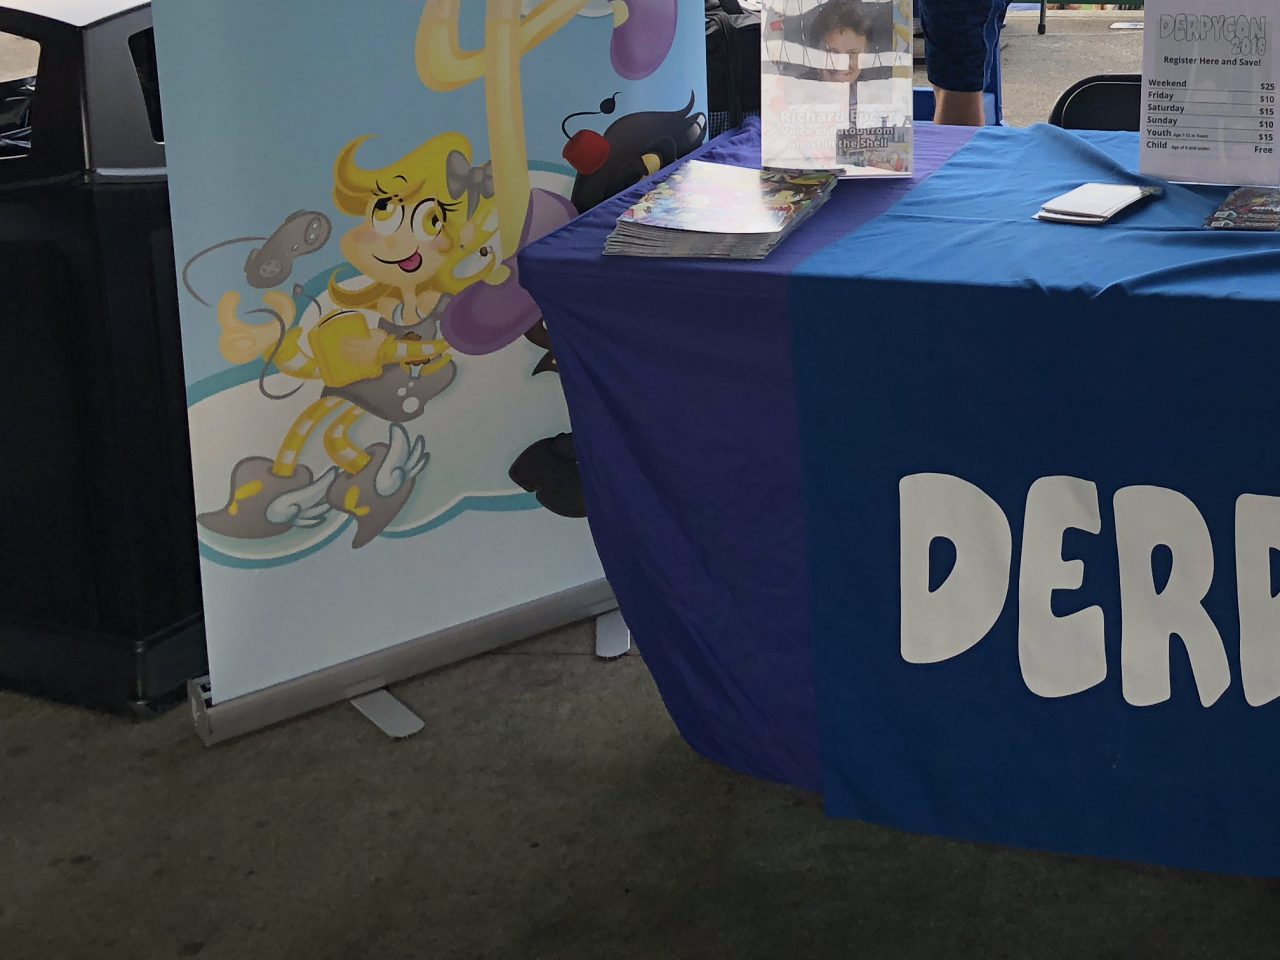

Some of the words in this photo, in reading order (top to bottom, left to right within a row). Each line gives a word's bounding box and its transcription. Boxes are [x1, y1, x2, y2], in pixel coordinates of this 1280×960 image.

[1159, 13, 1267, 42] DERPYCON
[1231, 36, 1267, 57] 2018
[1163, 56, 1198, 66] Register
[1199, 57, 1219, 65] Here
[1221, 58, 1237, 66] and
[1239, 58, 1262, 67] Save!
[1148, 79, 1187, 88] Weekend
[1260, 82, 1275, 91] $25
[1148, 91, 1174, 101] Friday
[1259, 95, 1275, 104] $10
[780, 109, 846, 123] Richard
[1147, 103, 1185, 114] Saturday
[1259, 108, 1274, 116] $15
[1147, 116, 1178, 126] Sunday
[1259, 120, 1274, 129] $10
[781, 126, 814, 136] Voice
[815, 126, 828, 135] of
[864, 125, 895, 135] from
[1147, 128, 1171, 137] Youth
[1258, 133, 1274, 142] $15
[787, 138, 820, 149] Ghost
[838, 138, 858, 149] the
[859, 138, 889, 149] Shell
[1146, 140, 1168, 149] Child
[1254, 145, 1273, 154] Free
